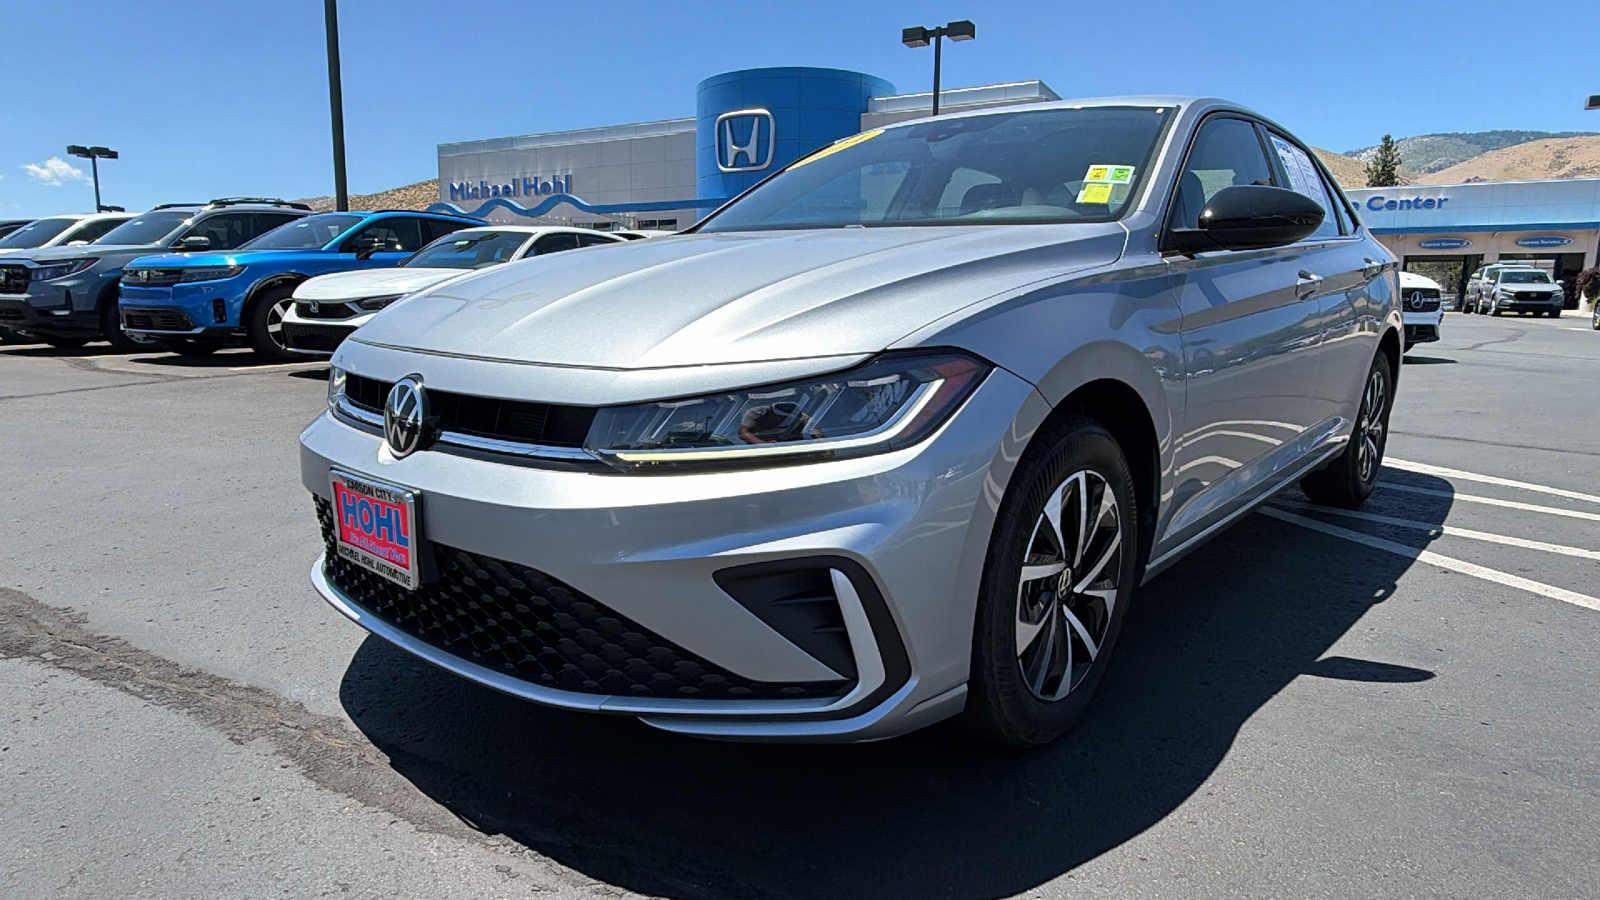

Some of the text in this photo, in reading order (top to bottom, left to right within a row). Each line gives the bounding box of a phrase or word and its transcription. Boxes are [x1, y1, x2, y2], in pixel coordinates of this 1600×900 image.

[450, 174, 569, 200] Michael Hohl
[1366, 195, 1449, 211] Center
[346, 480, 392, 501] CARSON CITY
[341, 491, 408, 547] HOHL
[339, 544, 411, 586] MICHAEL HOHL AUTOMOTIVE
